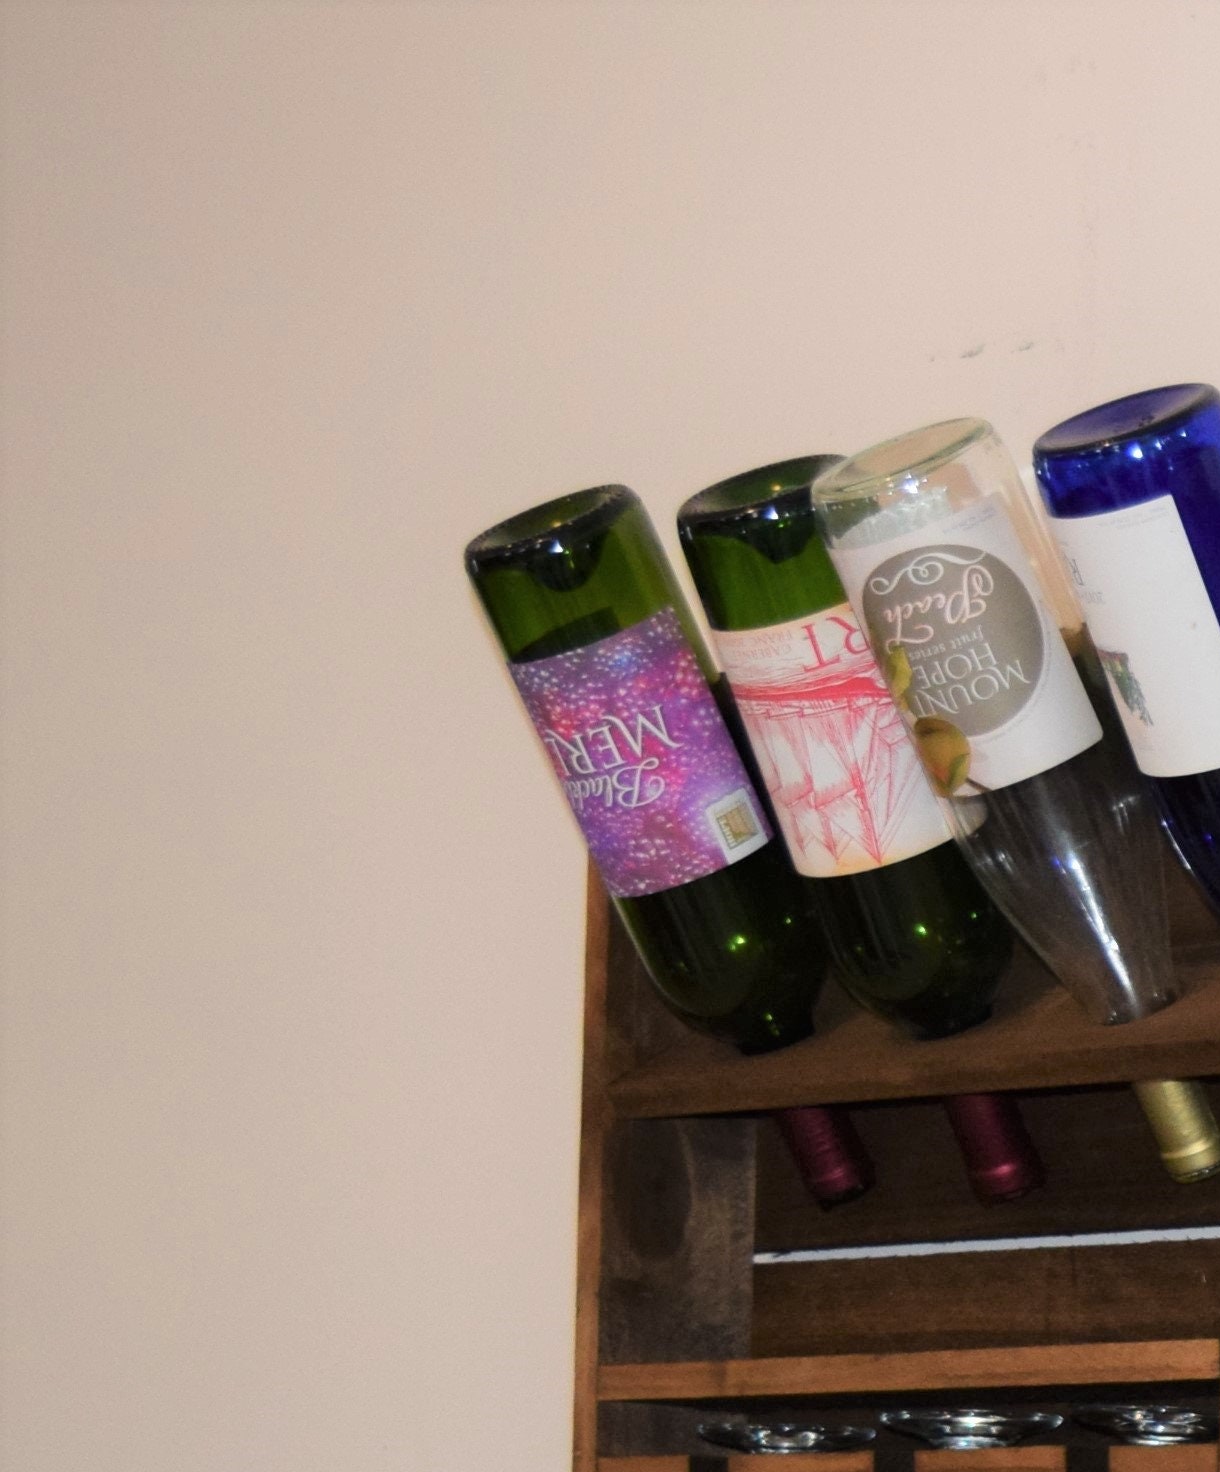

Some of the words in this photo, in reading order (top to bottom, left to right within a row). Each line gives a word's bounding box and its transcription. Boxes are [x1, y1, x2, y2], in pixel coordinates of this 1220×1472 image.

[883, 564, 995, 655] Peach
[950, 624, 984, 650] fruit
[912, 642, 997, 690] HOPE
[914, 659, 1031, 718] MOUNT
